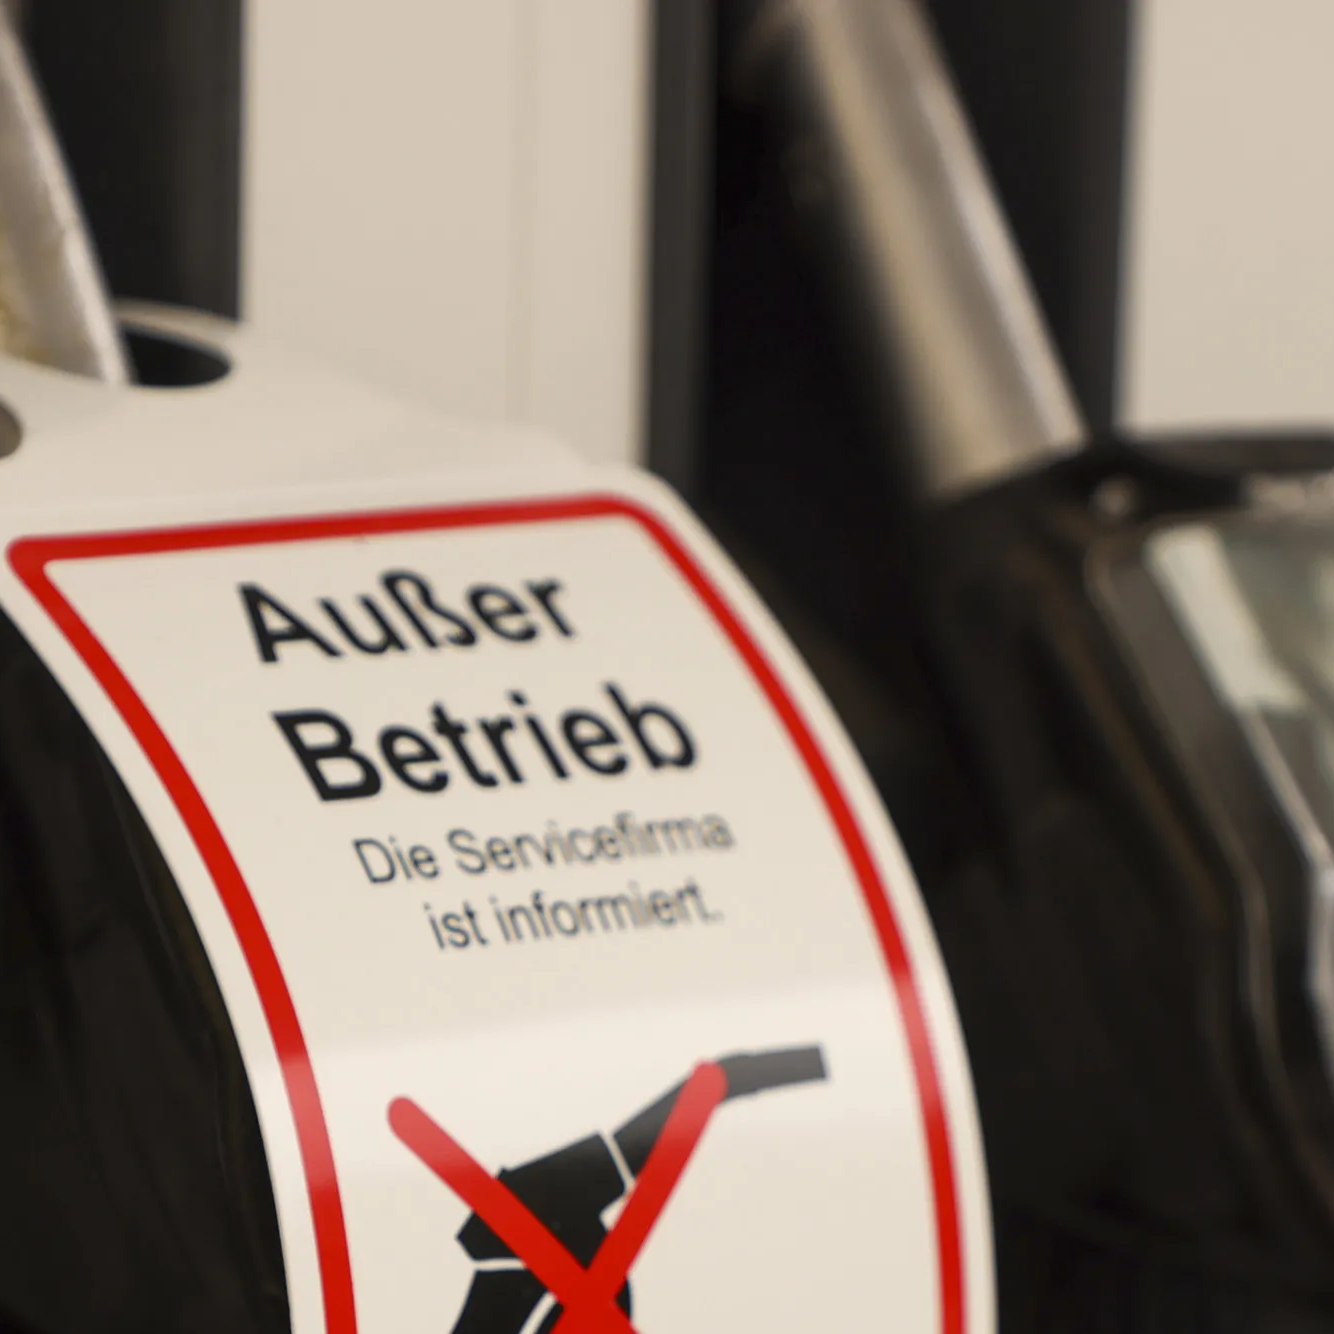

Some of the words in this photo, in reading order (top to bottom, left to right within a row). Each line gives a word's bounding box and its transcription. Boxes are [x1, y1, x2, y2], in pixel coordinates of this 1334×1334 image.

[239, 570, 573, 663] Außer
[272, 683, 697, 802] Betrieb
[352, 838, 439, 884] Die
[447, 813, 734, 875] Servicefirma
[424, 902, 488, 949] ist
[495, 883, 723, 942] informiert.
